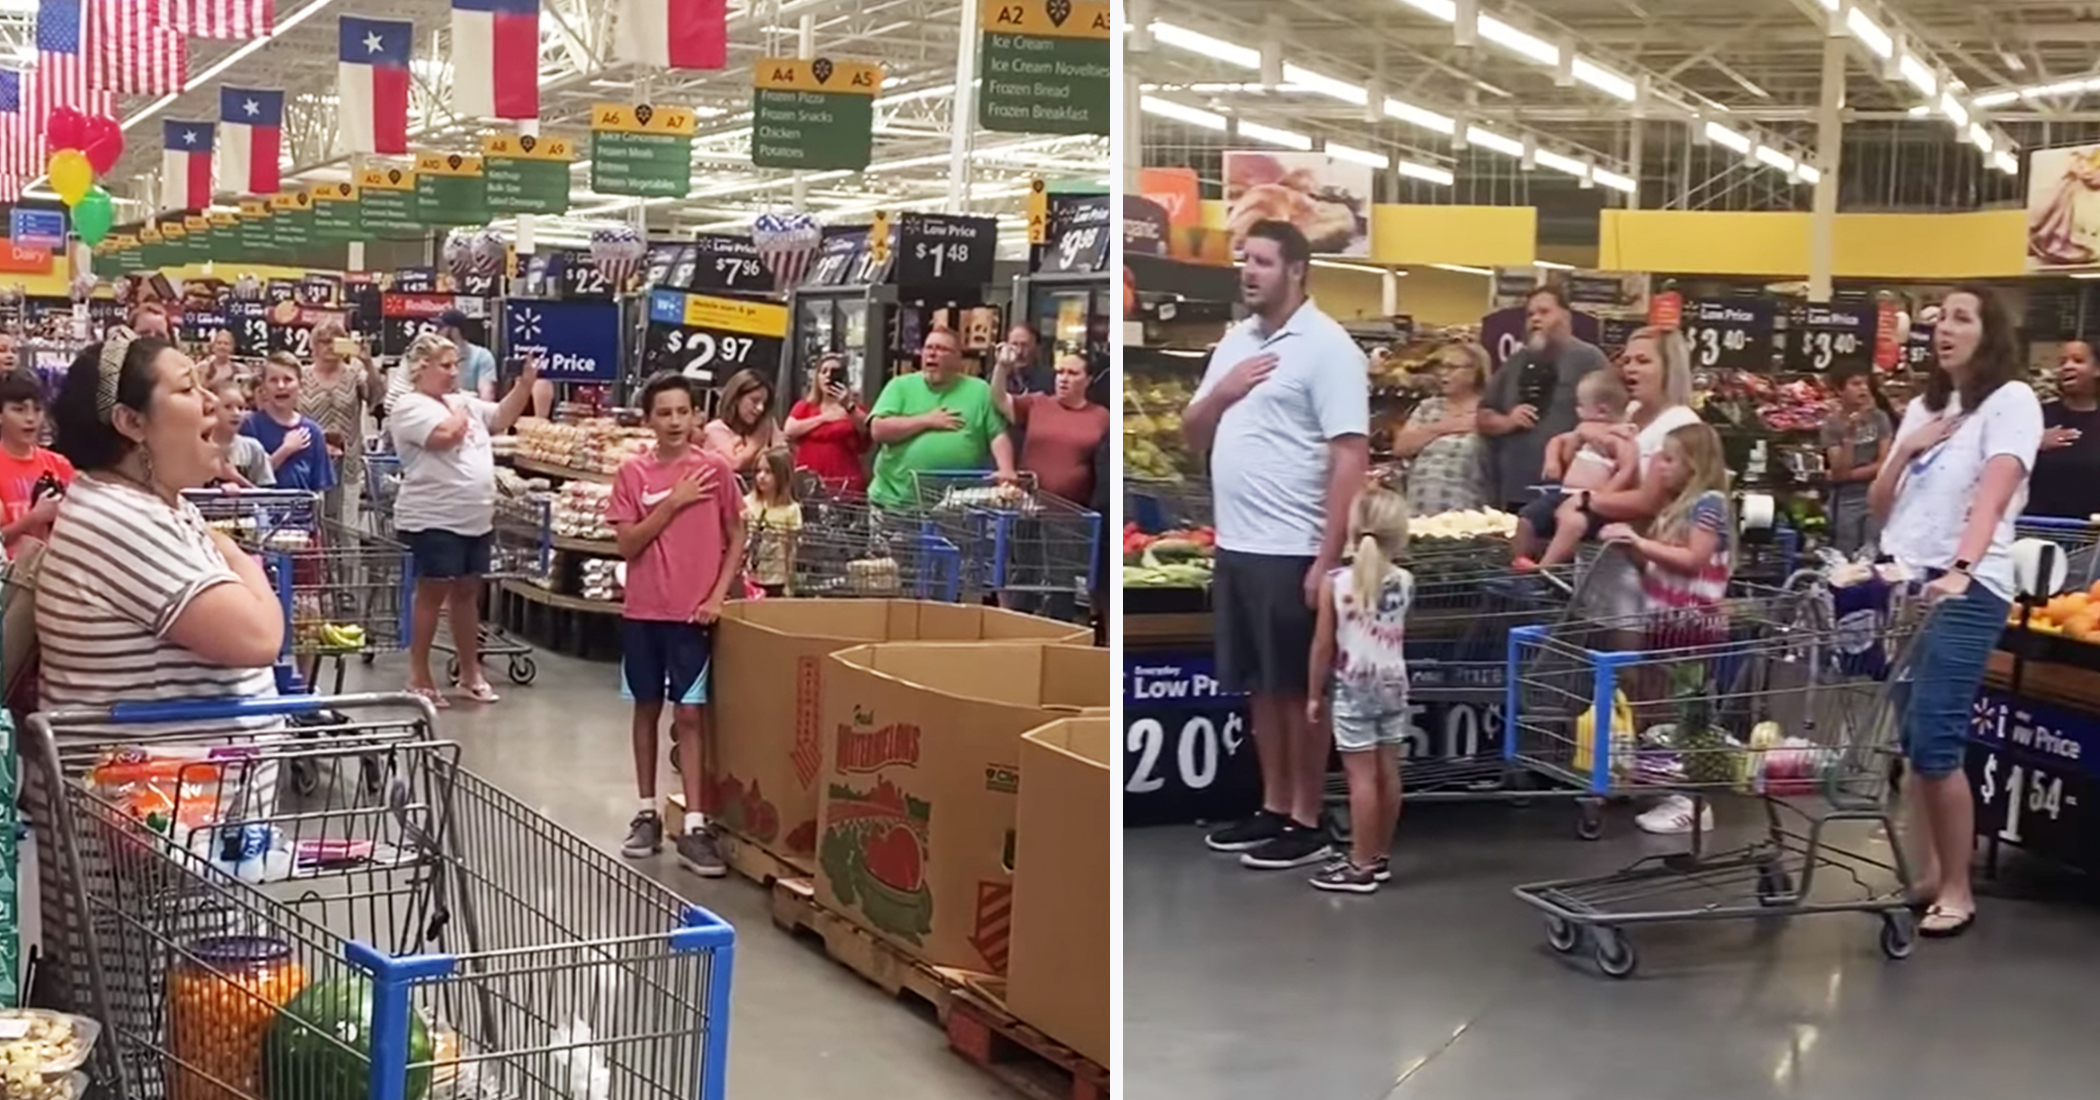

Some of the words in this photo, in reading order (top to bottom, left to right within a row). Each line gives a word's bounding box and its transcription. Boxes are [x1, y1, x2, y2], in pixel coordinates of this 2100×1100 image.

[997, 6, 1024, 24] A2
[992, 34, 1011, 49] Ice
[1013, 35, 1054, 51] Cream
[991, 57, 1010, 72] Ice
[1012, 58, 1052, 73] Cream
[771, 67, 794, 82] A4
[851, 71, 873, 87] A5
[989, 79, 1031, 95] Frozen
[1034, 82, 1070, 98] Bread
[601, 112, 619, 125] A6
[760, 107, 796, 121] Frozen
[798, 109, 833, 122] Snacks
[988, 101, 1030, 118] Frozen
[1032, 104, 1088, 121] Breakfast
[760, 126, 801, 139] Chicken
[760, 144, 804, 158] Potatoes
[923, 223, 947, 236] Low
[949, 224, 977, 238] Price
[12, 246, 45, 263] Dairy
[552, 353, 597, 372] Price
[1134, 677, 1190, 699] Low
[2034, 725, 2081, 760] Price
